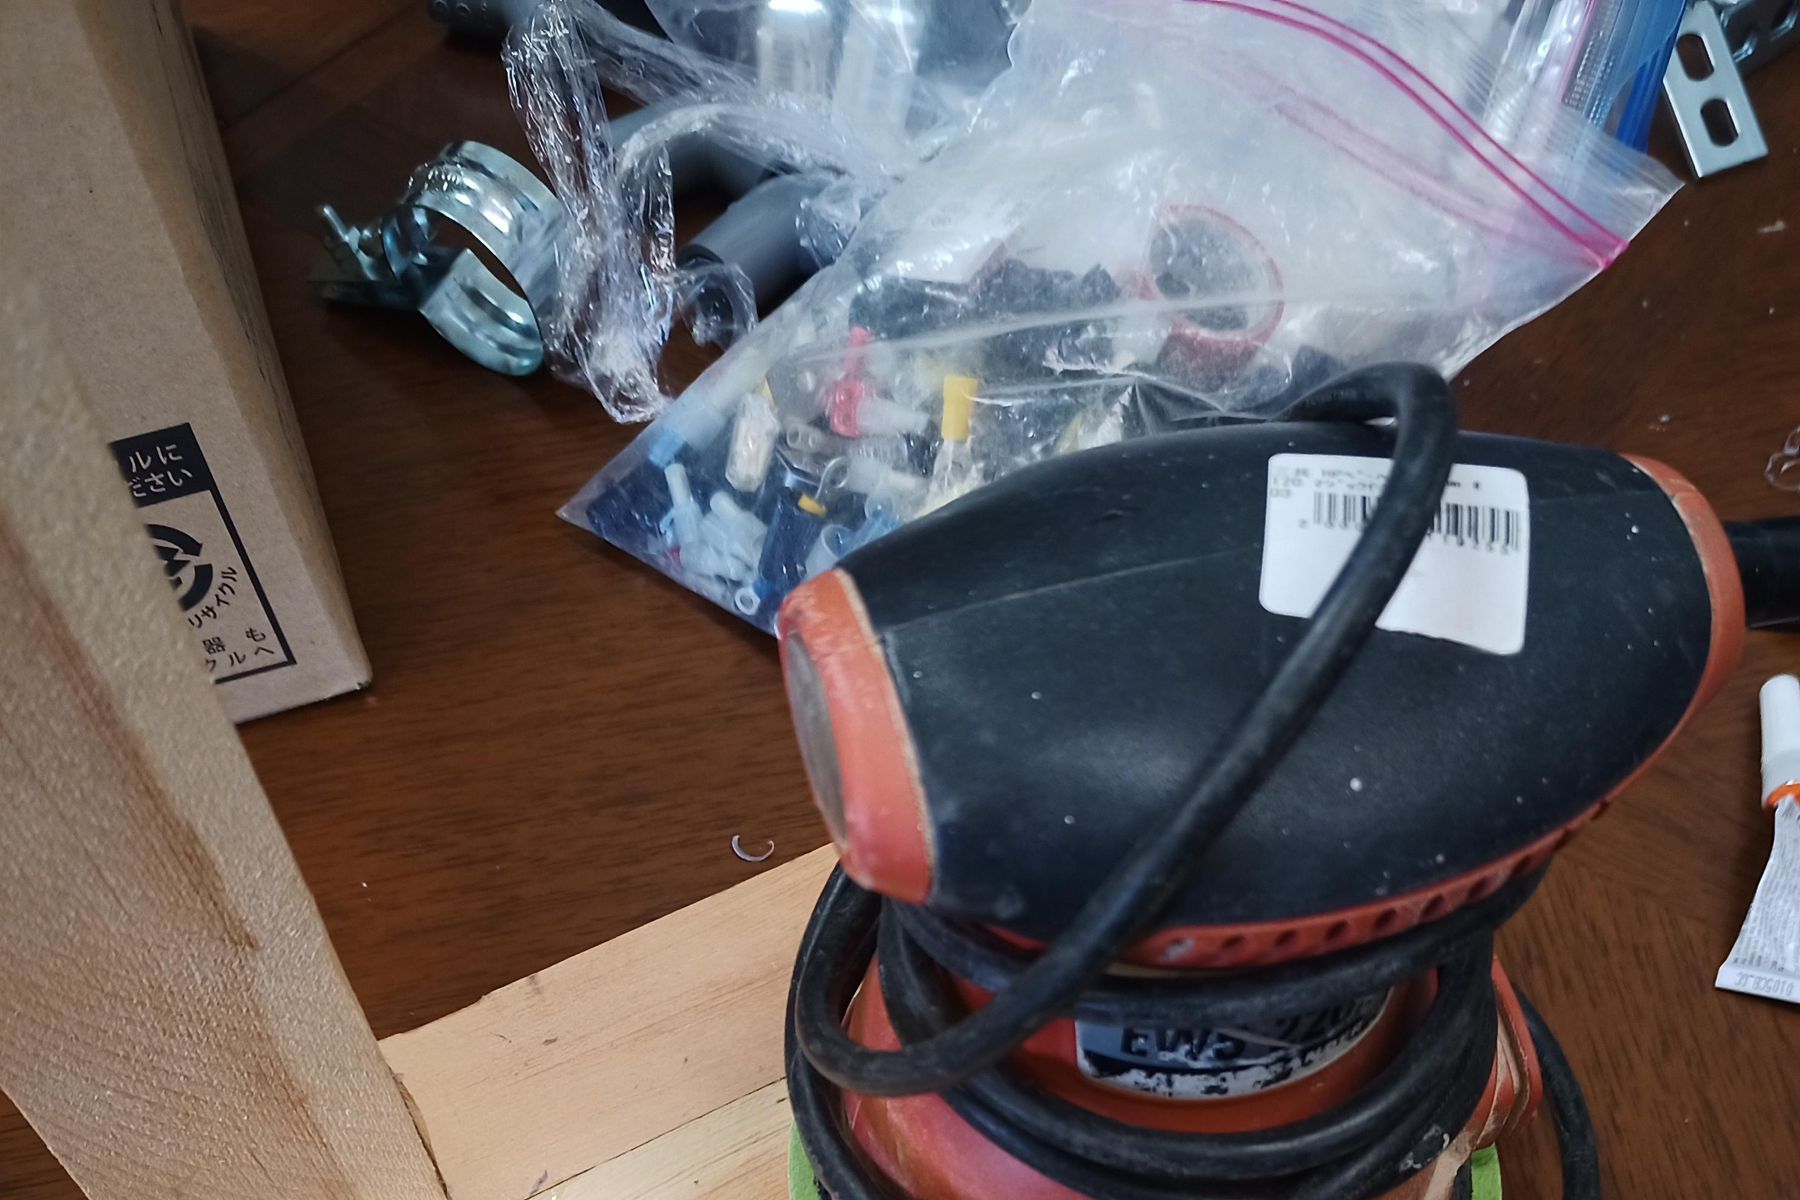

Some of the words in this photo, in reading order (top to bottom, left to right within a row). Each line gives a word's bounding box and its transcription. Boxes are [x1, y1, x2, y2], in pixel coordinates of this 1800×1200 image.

[188, 566, 238, 628] リサイクル
